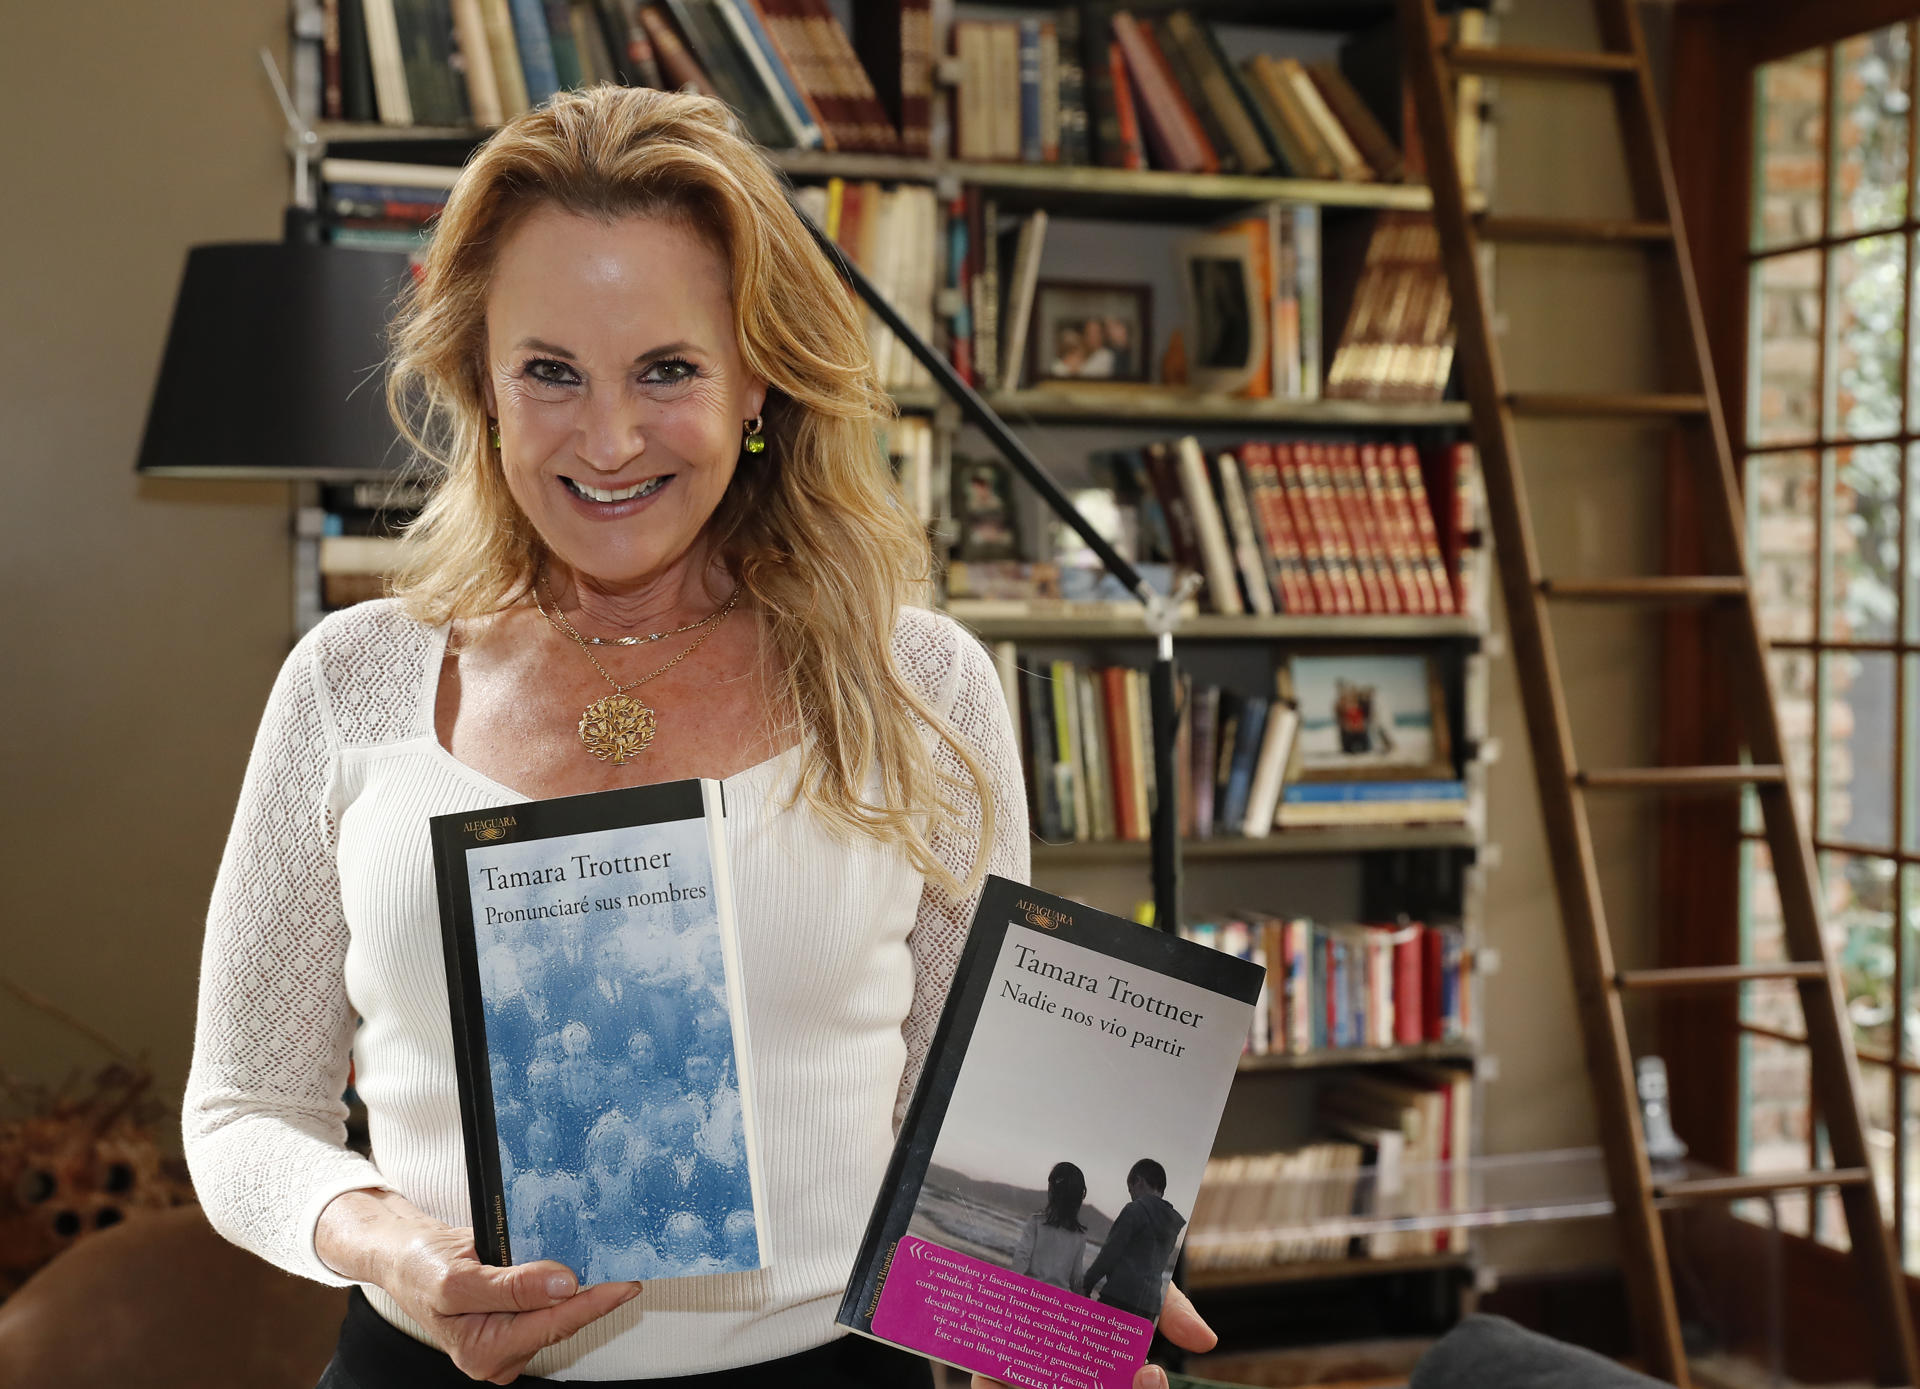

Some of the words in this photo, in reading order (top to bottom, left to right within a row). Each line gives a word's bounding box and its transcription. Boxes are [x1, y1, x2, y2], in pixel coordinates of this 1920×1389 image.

[464, 816, 517, 832] ALFAGUARA
[480, 867, 566, 891] Tamara
[571, 851, 672, 880] Trottner
[485, 896, 590, 925] Pronunciaré
[595, 896, 622, 912] sus
[627, 882, 707, 908] nombres
[1016, 899, 1074, 926] ALFAGUARA
[1014, 944, 1098, 994] Tamara
[1108, 976, 1203, 1029] Trottner
[1000, 980, 1057, 1014] Nadie
[1061, 1005, 1094, 1027] nos
[1098, 1018, 1127, 1039] vio
[1130, 1030, 1186, 1058] partir
[499, 1236, 508, 1267] arrativa
[864, 1282, 883, 1318] Narrativa
[877, 1242, 896, 1280] Hispánica
[916, 1280, 939, 1292] como
[940, 1288, 963, 1300] quien
[965, 1294, 983, 1308] lleva
[985, 1304, 1003, 1315] toda
[1005, 1309, 1012, 1318] la
[1014, 1313, 1030, 1325] vida
[1082, 1336, 1110, 1353] Porque
[1111, 1349, 1134, 1362] quien
[925, 1295, 960, 1314] descubre
[960, 1310, 967, 1318] y
[968, 1311, 1003, 1330] entiende
[1004, 1324, 1012, 1332] el
[1013, 1326, 1035, 1340] dolor
[1044, 1337, 1054, 1348] las
[1056, 1342, 1081, 1357] dichas
[1083, 1352, 1092, 1361] de
[928, 1269, 934, 1277] y
[936, 1270, 974, 1290] sabiduría.
[977, 1283, 1006, 1301] Tamara
[1008, 1294, 1040, 1312] Trottner
[1042, 1308, 1069, 1323] escribe
[1070, 1319, 1080, 1328] su
[1081, 1323, 1109, 1338] primer
[1110, 1331, 1130, 1345] libro
[980, 1272, 988, 1281] y
[989, 1274, 1028, 1294] fascinante
[1064, 1303, 1088, 1317] escrita
[1091, 1313, 1106, 1322] con
[1107, 1317, 1143, 1336] elegancia
[934, 1314, 947, 1324] teje
[960, 1322, 989, 1339] destino
[991, 1335, 1006, 1345] con
[1008, 1341, 1042, 1358] madurez
[1044, 1354, 1050, 1362] y
[1050, 1357, 1099, 1379] generosidad.
[934, 1326, 952, 1341] Éste
[976, 1342, 995, 1356] libro
[997, 1352, 1012, 1363] que
[1014, 1359, 1052, 1377] emociona
[1061, 1372, 1088, 1389] fascina
[1002, 1365, 1048, 1389] ÁNGELES
